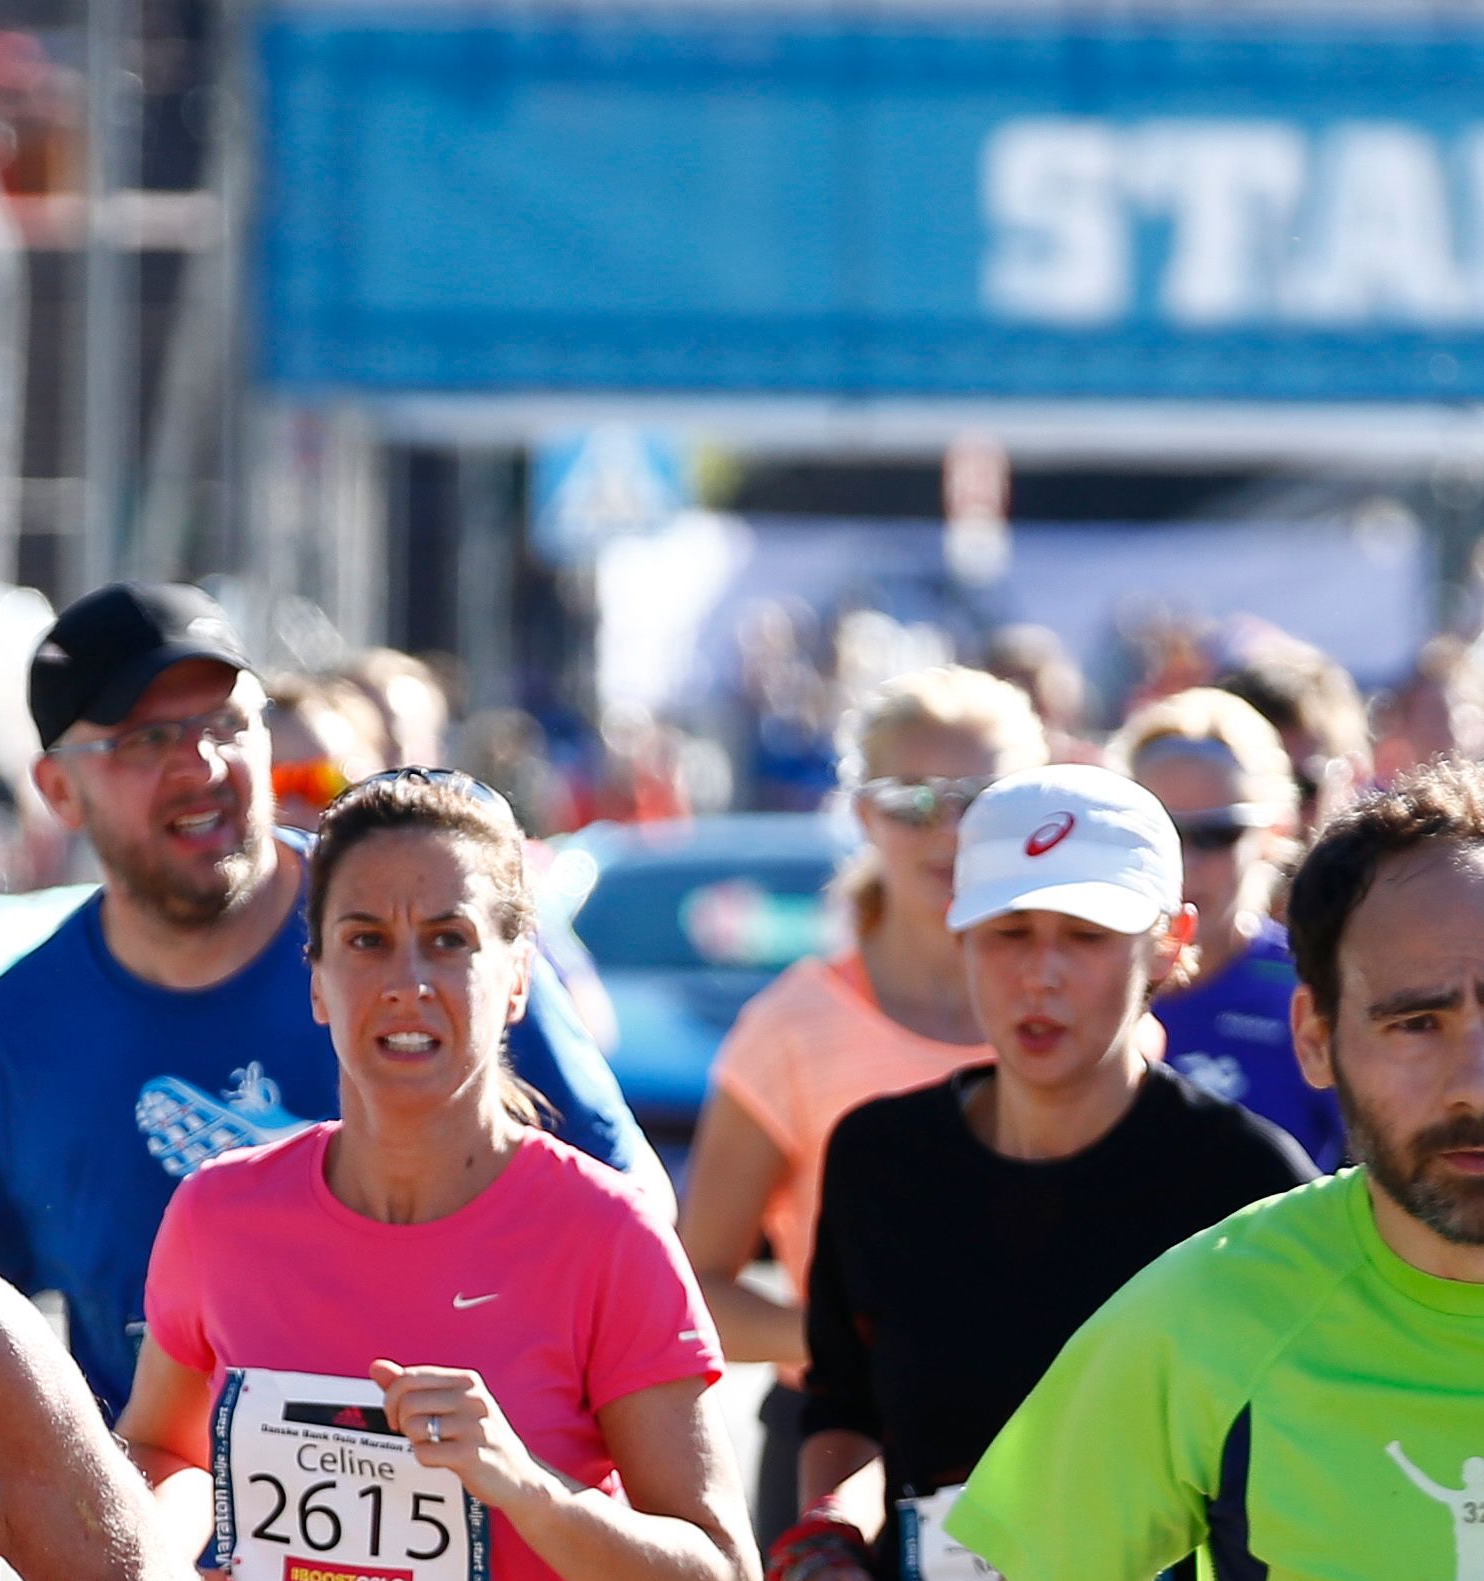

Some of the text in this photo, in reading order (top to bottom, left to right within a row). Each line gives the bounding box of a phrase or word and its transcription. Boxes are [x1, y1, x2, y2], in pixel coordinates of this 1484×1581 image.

[261, 1423, 298, 1436] Danske
[302, 1430, 329, 1441] Bank
[360, 1438, 403, 1451] Maraton
[297, 1443, 395, 1481] Celine
[248, 1473, 451, 1561] 2615
